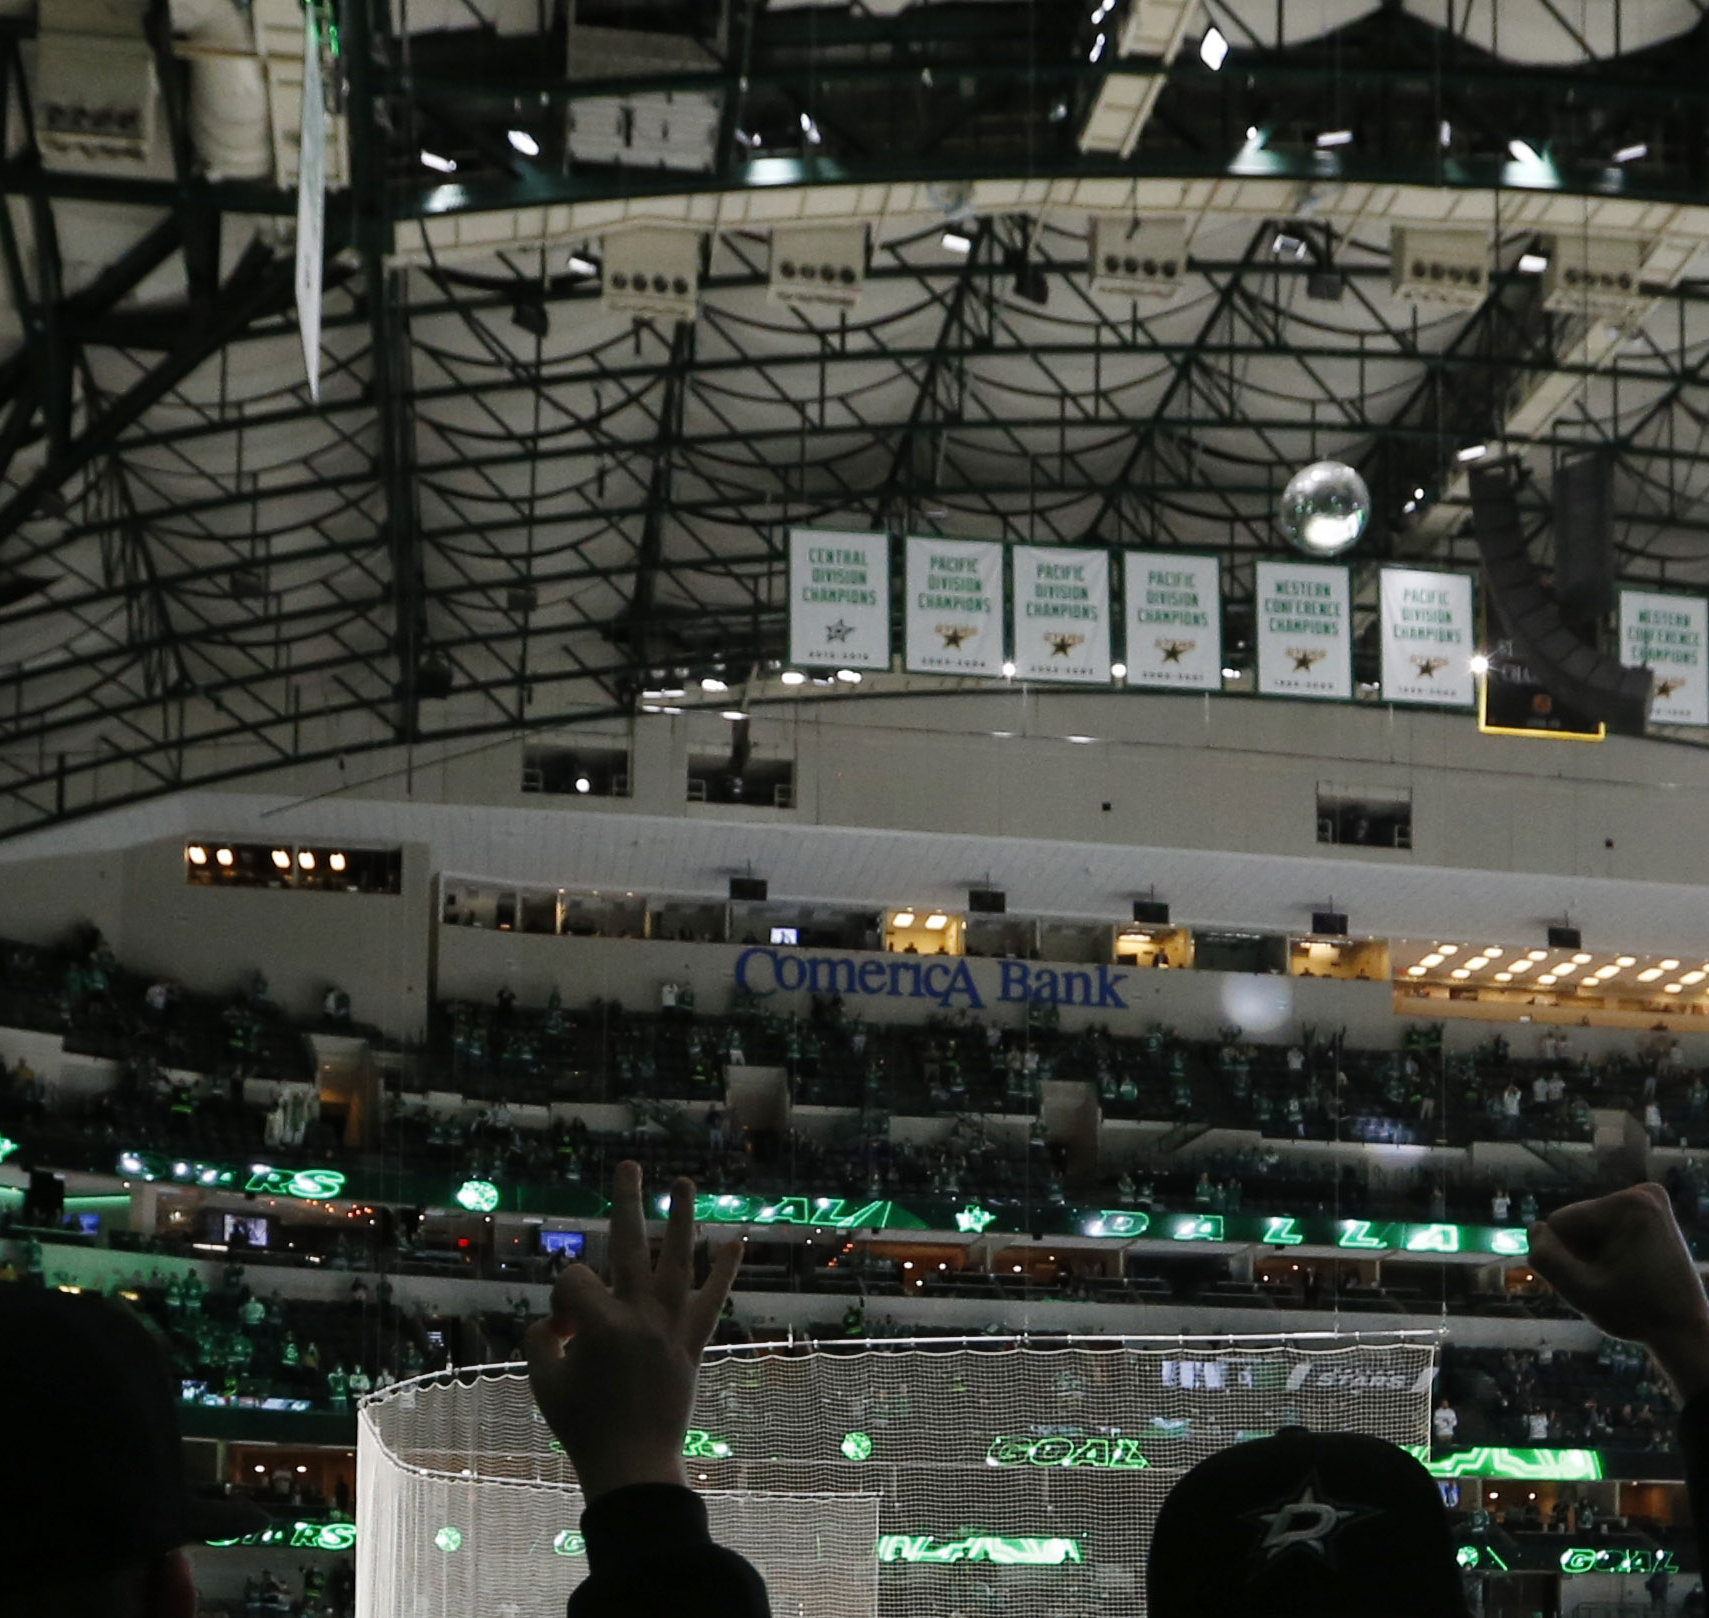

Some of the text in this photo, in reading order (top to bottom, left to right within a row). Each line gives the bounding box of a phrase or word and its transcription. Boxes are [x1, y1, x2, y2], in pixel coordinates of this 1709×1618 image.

[930, 554, 980, 574] PACIFIC
[1036, 563, 1085, 582] PACIFIC
[811, 567, 868, 585] DIVISION
[927, 573, 983, 593] DIVISION
[1147, 569, 1196, 588] PACIFIC
[802, 587, 877, 606] CHAMPIONS
[917, 593, 992, 614] CHAMPIONS
[1025, 601, 1099, 622] CHAMPIONS
[1137, 607, 1210, 628] CHAMPIONS
[1268, 616, 1340, 636] CHAMPIONS
[1393, 623, 1463, 645] CHAMPIONS
[997, 958, 1130, 1009] Bank
[986, 1435, 1152, 1469] GOAL
